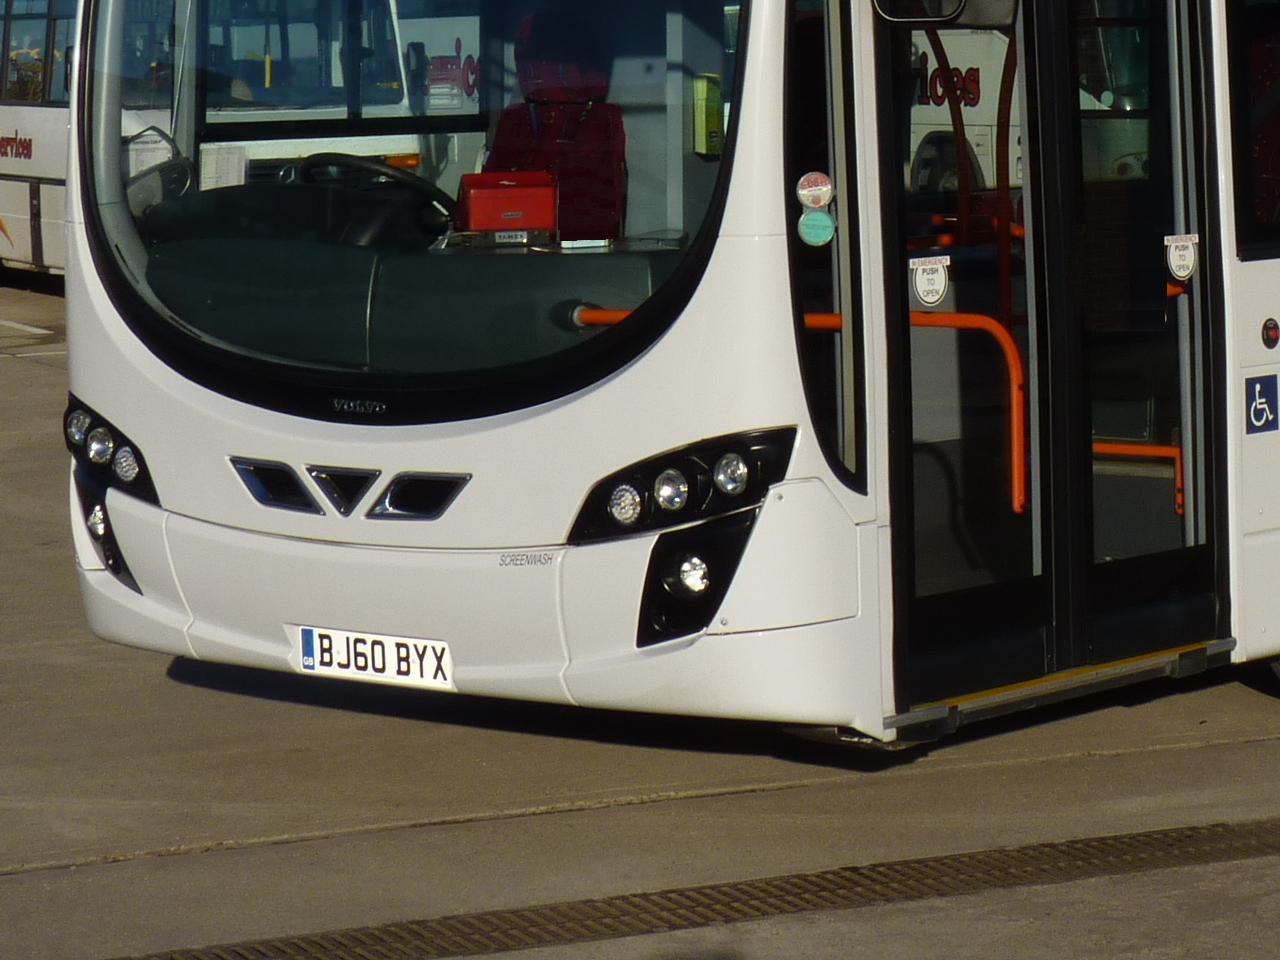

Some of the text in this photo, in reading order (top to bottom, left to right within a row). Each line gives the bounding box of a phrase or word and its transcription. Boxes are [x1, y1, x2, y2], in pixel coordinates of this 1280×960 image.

[921, 267, 939, 276] PUSH
[1175, 264, 1190, 273] OPEN
[927, 277, 936, 286] TO
[922, 288, 940, 298] OPEN
[334, 399, 387, 414] VOLVO
[499, 552, 554, 567] SCREENWASH
[303, 633, 448, 682] GB BJ60 BYX
